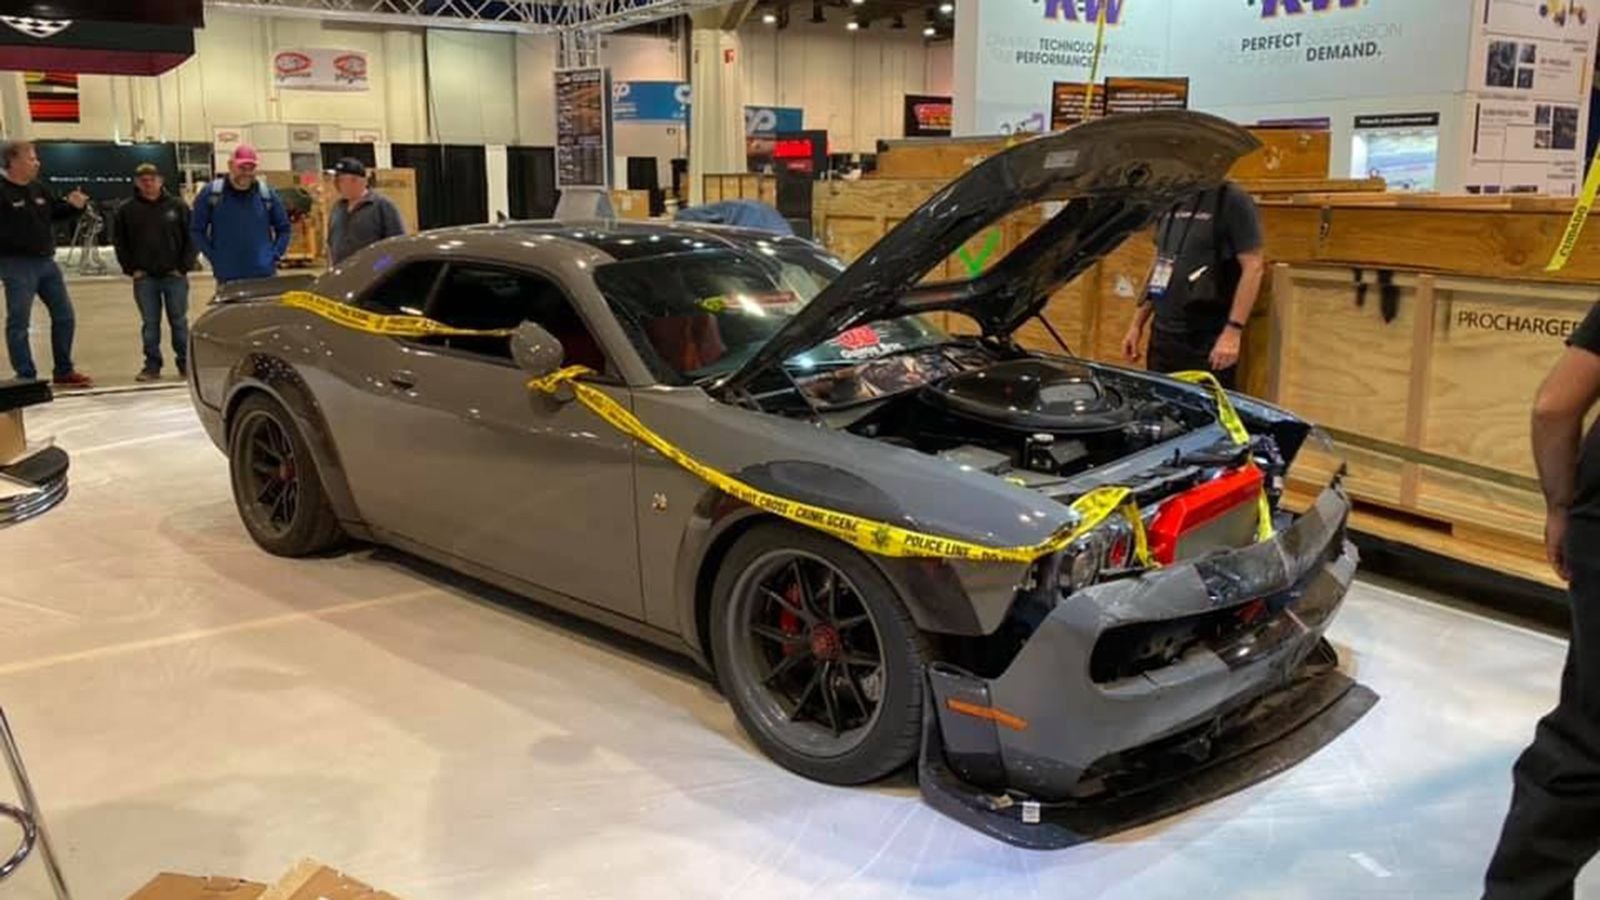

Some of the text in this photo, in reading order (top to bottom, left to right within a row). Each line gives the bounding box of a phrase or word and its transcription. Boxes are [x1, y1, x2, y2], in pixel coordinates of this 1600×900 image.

[1039, 38, 1108, 55] TECHNOLOY
[1241, 33, 1303, 51] PERFECT
[1306, 41, 1383, 62] DEMAND.
[1015, 51, 1094, 68] PERFORMANCE
[1559, 205, 1587, 257] CUIDADO
[757, 496, 789, 514] CROSS
[795, 506, 827, 524] CRIME
[826, 514, 859, 533] SCENE
[904, 534, 943, 551] POLICE
[944, 544, 972, 557] LINE
